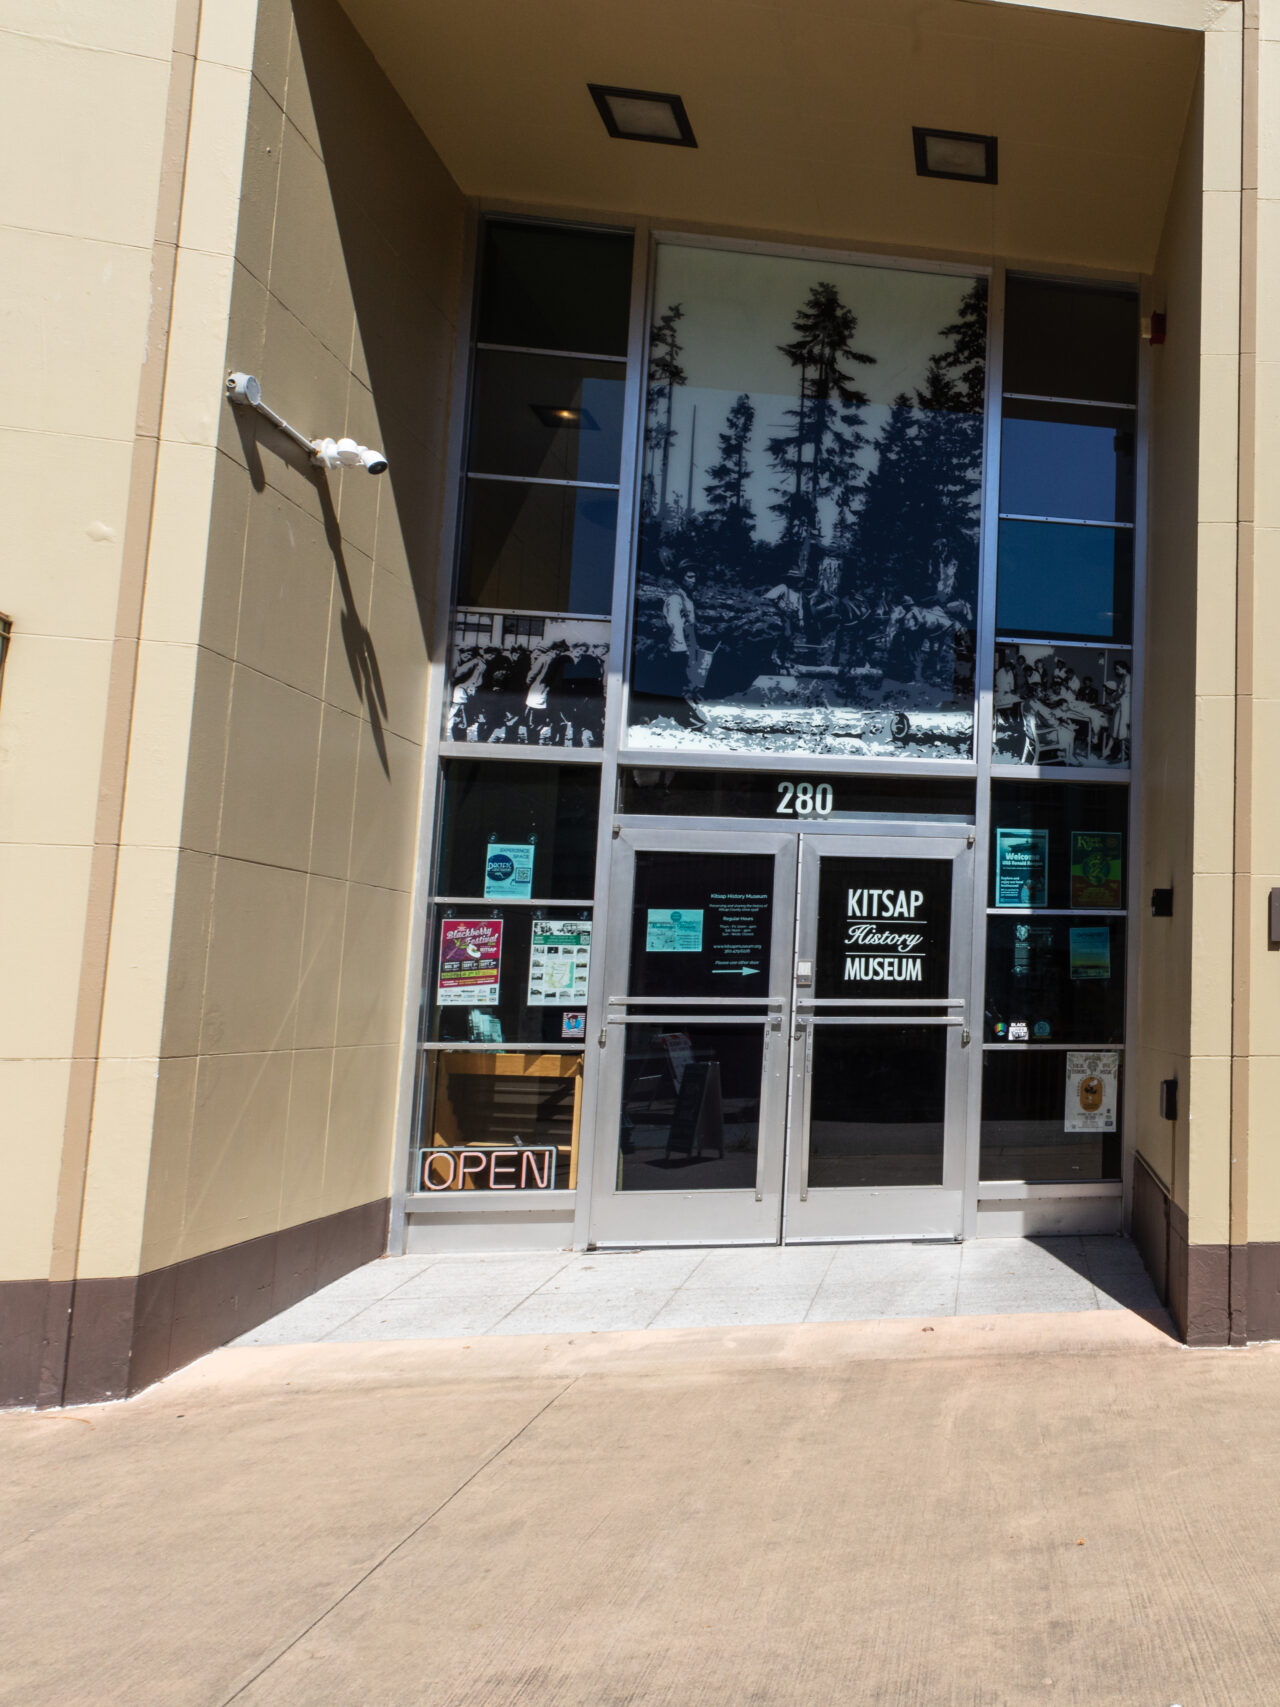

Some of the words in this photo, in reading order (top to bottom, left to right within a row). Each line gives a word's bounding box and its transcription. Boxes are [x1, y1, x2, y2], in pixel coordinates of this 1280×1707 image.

[776, 781, 833, 815] 280
[1005, 852, 1040, 860] Welcome
[847, 888, 924, 918] KITSAP
[446, 927, 492, 939] Blackberry
[465, 933, 499, 944] Festival
[844, 924, 923, 952] History
[844, 957, 922, 981] MUSEUM
[424, 1151, 550, 1190] OPEN
